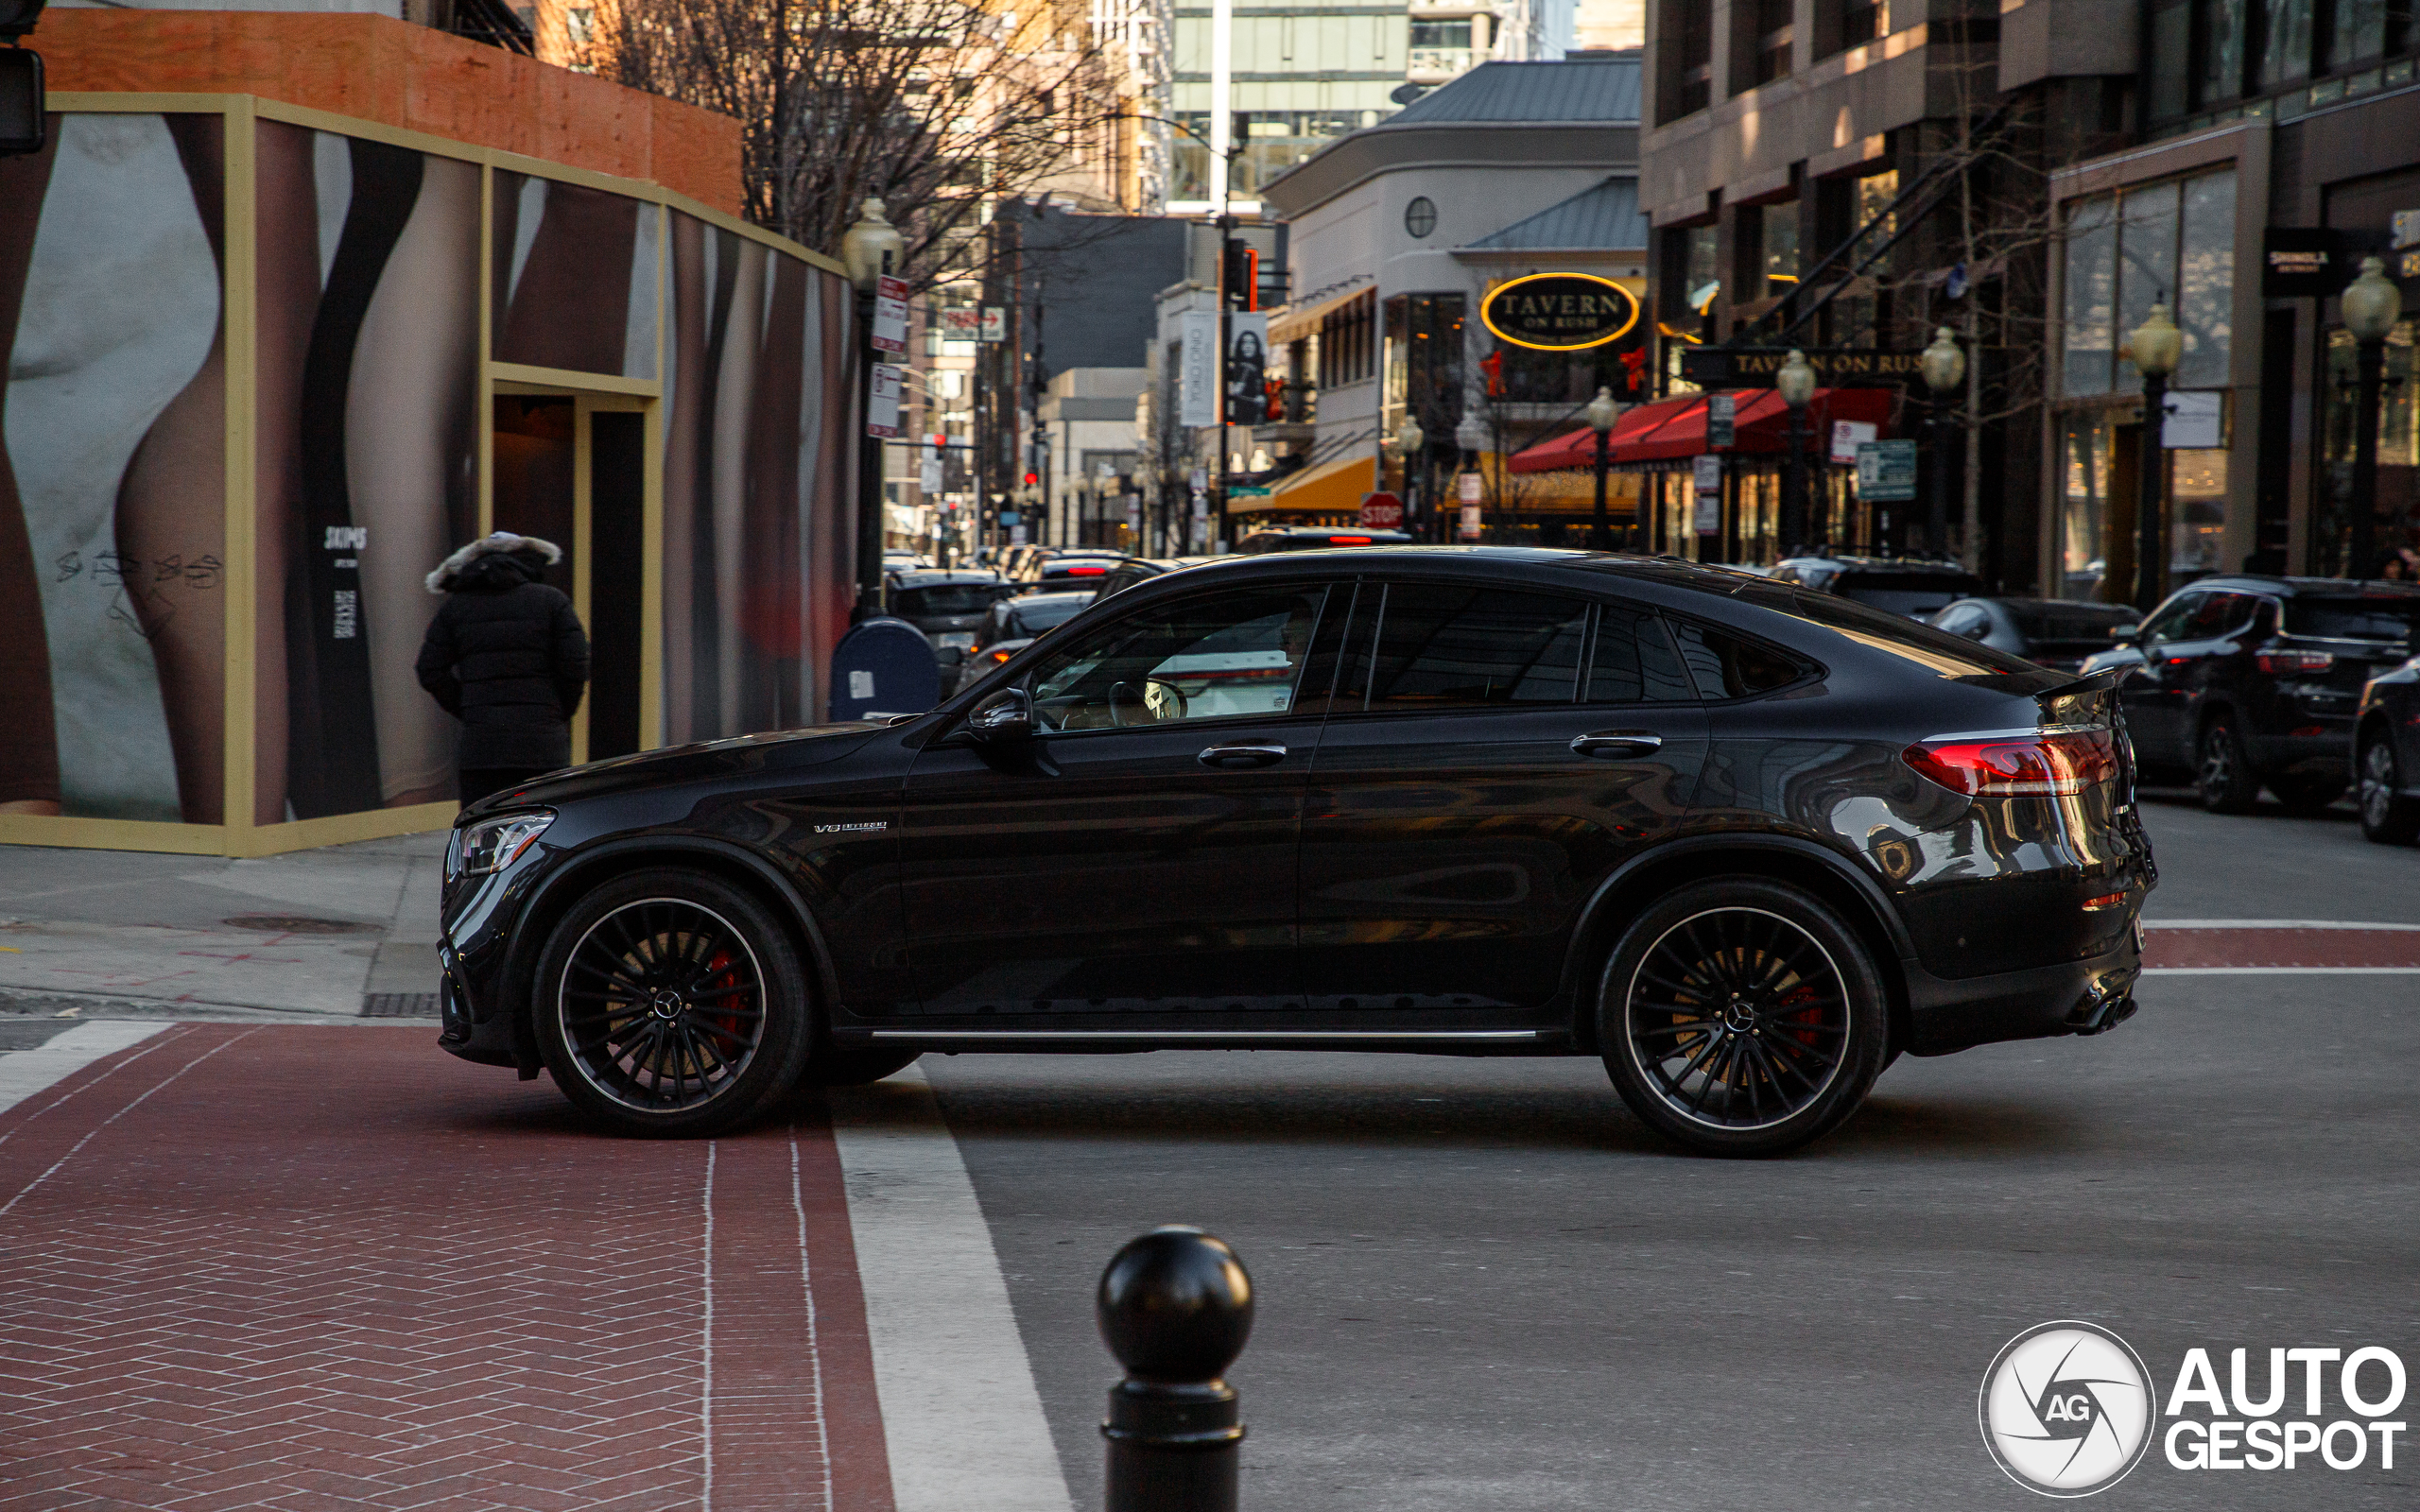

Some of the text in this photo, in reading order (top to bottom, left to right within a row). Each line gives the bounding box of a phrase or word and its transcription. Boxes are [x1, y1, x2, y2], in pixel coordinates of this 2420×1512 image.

[1500, 294, 1620, 315] TAVERN
[1523, 317, 1548, 328] ON
[1833, 355, 1872, 372] ON
[1878, 355, 1924, 372] RUS
[1363, 506, 1403, 524] STOP
[814, 824, 840, 833] V8
